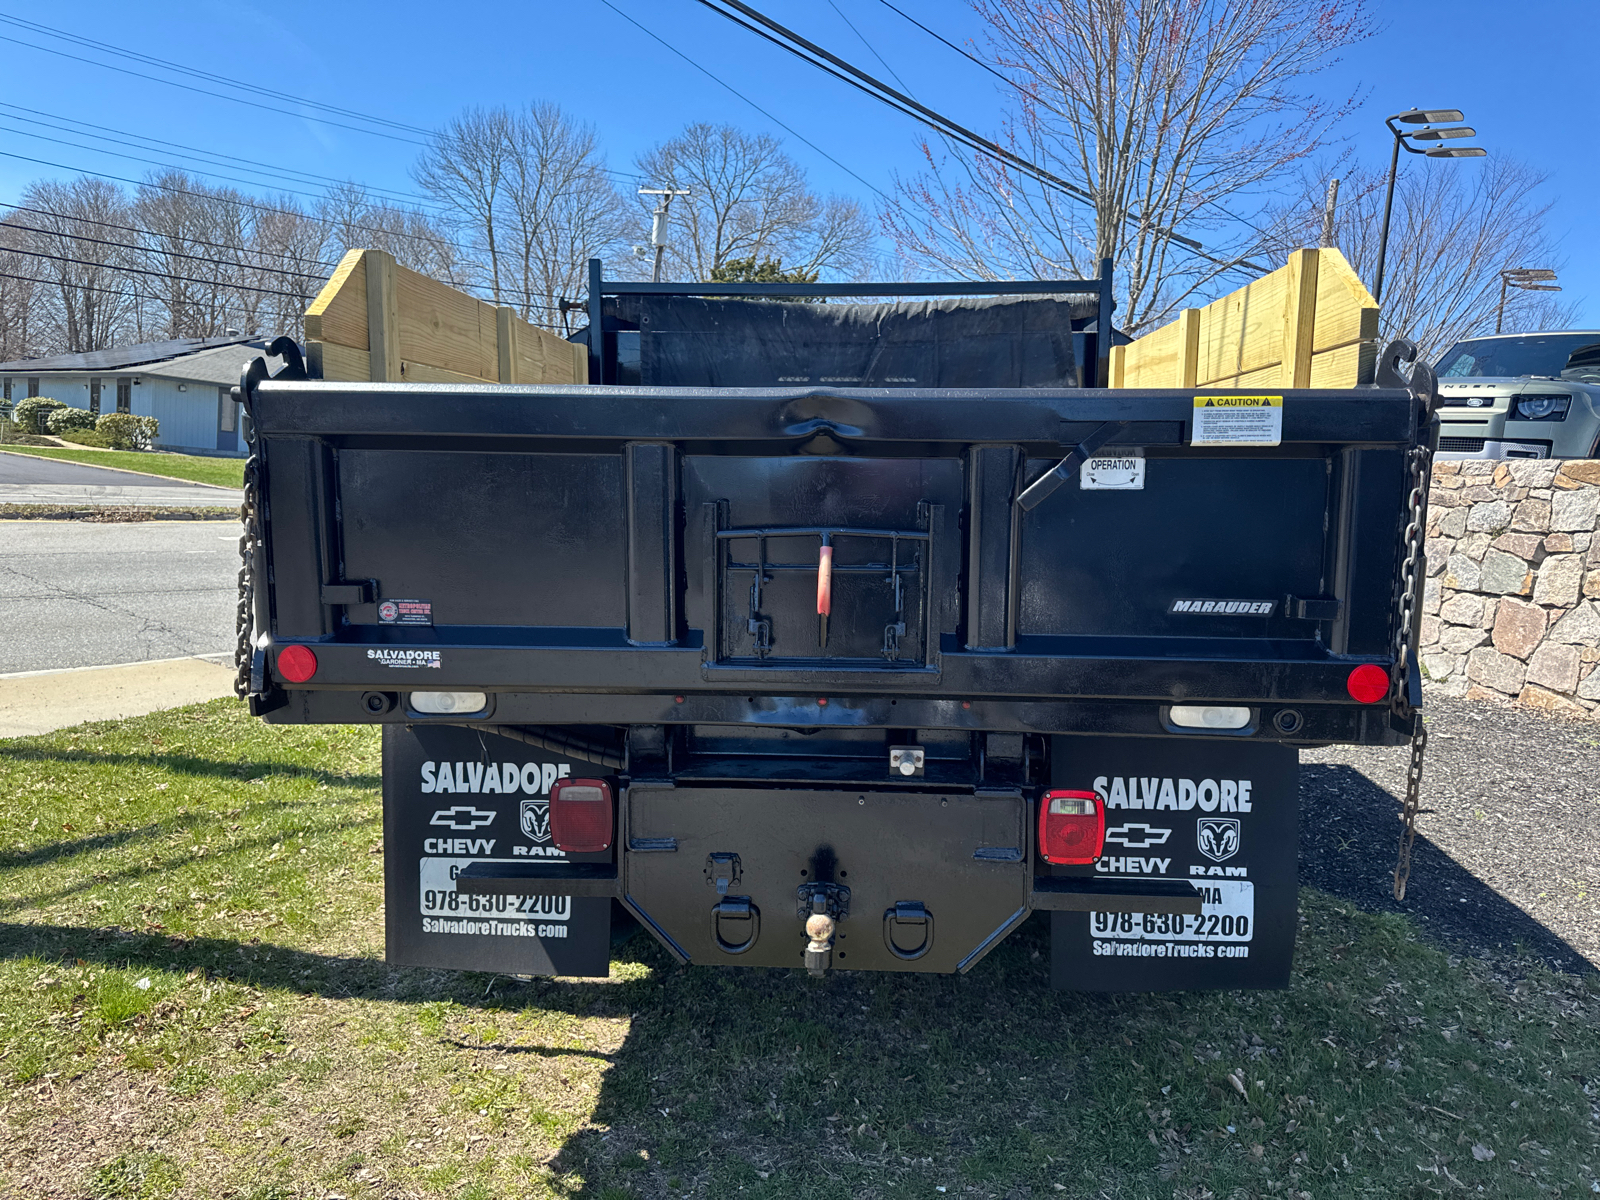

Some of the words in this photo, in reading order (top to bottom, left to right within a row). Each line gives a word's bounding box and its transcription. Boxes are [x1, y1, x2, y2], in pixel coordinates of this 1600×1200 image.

[1217, 398, 1260, 406] CAUTION
[1091, 459, 1136, 470] OPERATION
[1172, 600, 1273, 614] MARAUDER
[367, 649, 440, 660] SALVADORE
[1093, 776, 1253, 813] SALVADORE
[424, 838, 496, 855] CHEVY
[513, 846, 566, 856] RAM
[1095, 856, 1172, 873] CHEVY
[1190, 865, 1248, 877] RAM
[424, 889, 567, 915] 978-630-2200
[1095, 911, 1249, 937] 978-630-2200
